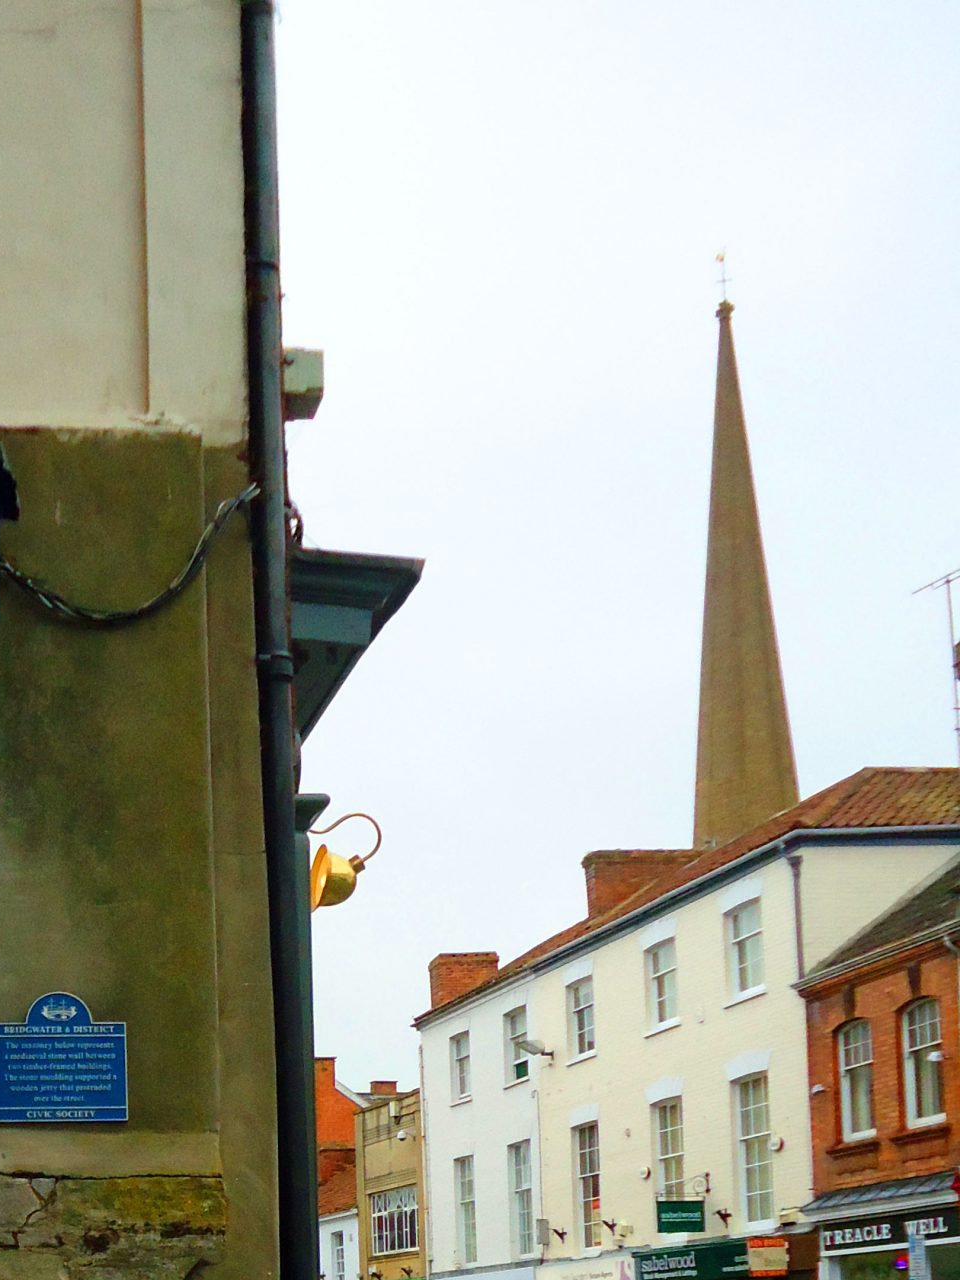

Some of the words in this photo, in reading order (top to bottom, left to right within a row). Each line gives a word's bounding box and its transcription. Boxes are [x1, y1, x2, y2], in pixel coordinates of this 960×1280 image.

[3, 1025, 63, 1034] BRIDGWATER
[73, 1025, 115, 1033] DISTRICT
[26, 1110, 53, 1118] CIVIC
[55, 1110, 96, 1118] SOCIETY
[824, 1223, 892, 1246] TREACLE
[904, 1216, 948, 1236] WELL
[641, 1251, 696, 1272] sabelwood
